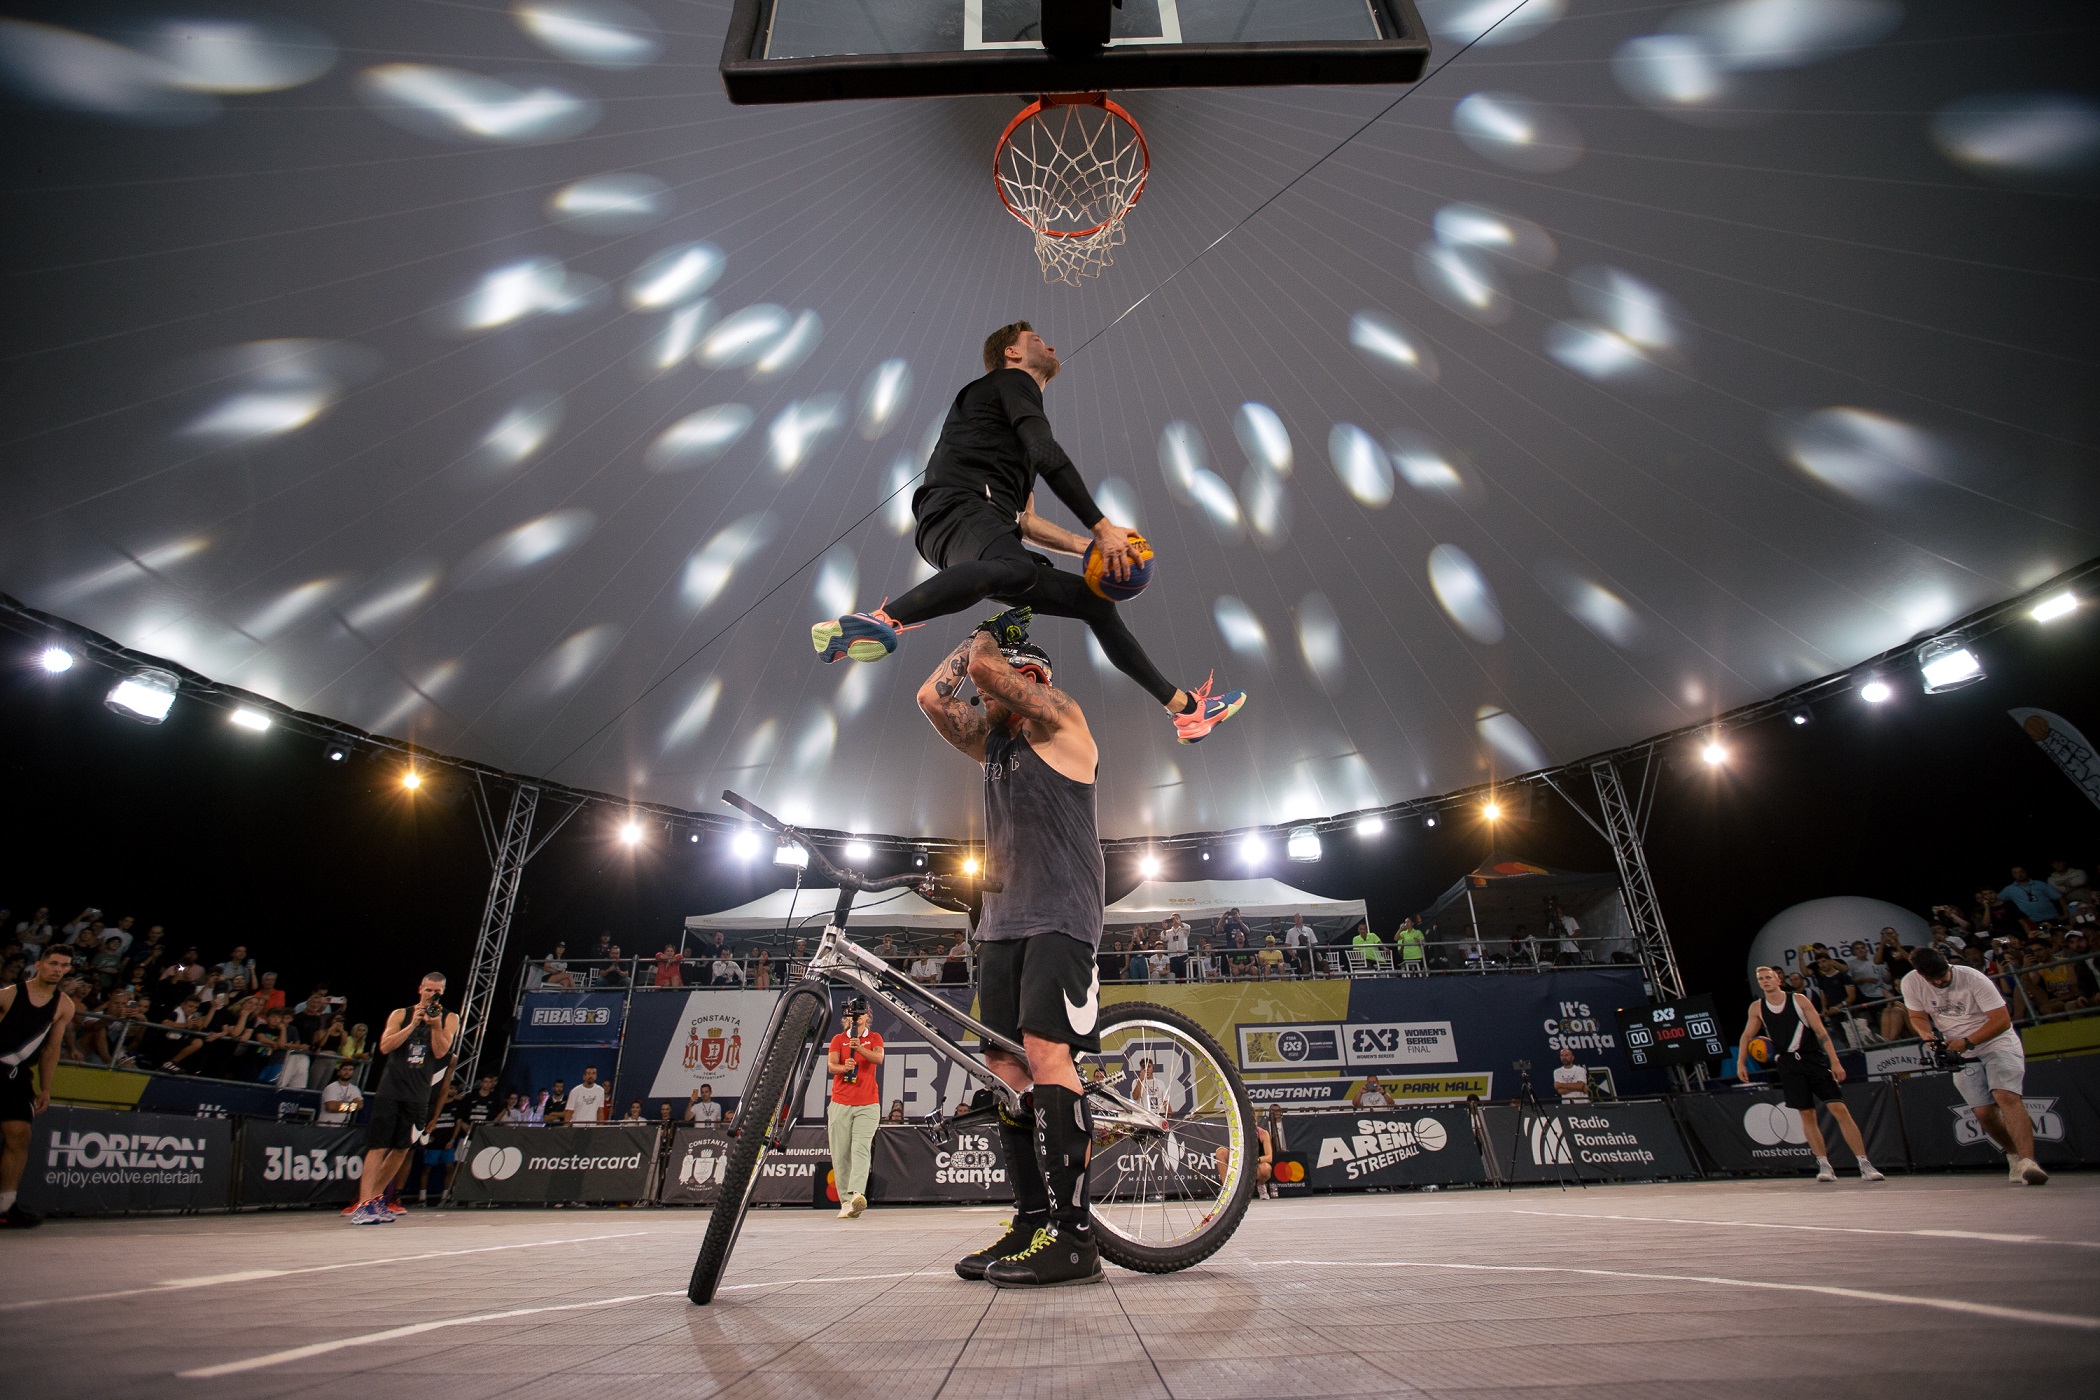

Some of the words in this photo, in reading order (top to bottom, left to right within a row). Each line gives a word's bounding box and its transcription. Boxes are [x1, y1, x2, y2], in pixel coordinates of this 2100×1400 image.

[532, 1009, 572, 1025] FIBA
[1559, 1001, 1591, 1018] It's
[1404, 1028, 1447, 1037] WOMEN'S
[1655, 1026, 1686, 1041] 10:00
[1691, 1021, 1712, 1036] 00
[1406, 1036, 1438, 1045] SERIES
[1630, 1031, 1649, 1045] 00
[1407, 1045, 1431, 1053] FINAL
[1876, 1056, 1918, 1072] CONSTANT
[1402, 1082, 1441, 1094] PARK
[1444, 1080, 1483, 1092] MALL
[1357, 1119, 1413, 1135] SPORT
[1567, 1115, 1610, 1129] Radio
[958, 1134, 989, 1151] It's
[1573, 1132, 1638, 1147] România
[48, 1130, 207, 1170] HORIZON
[785, 1148, 831, 1156] MUNICIPIU
[1316, 1131, 1417, 1169] ARENA
[1751, 1147, 1813, 1158] mastercar
[528, 1152, 641, 1170] mastercard
[1117, 1154, 1159, 1172] CITY
[1187, 1153, 1218, 1170] PAR
[1345, 1145, 1420, 1180] STREETBALL
[45, 1168, 203, 1188] enjoy.evolve.entertain.
[1174, 1174, 1222, 1182] CONSTANT
